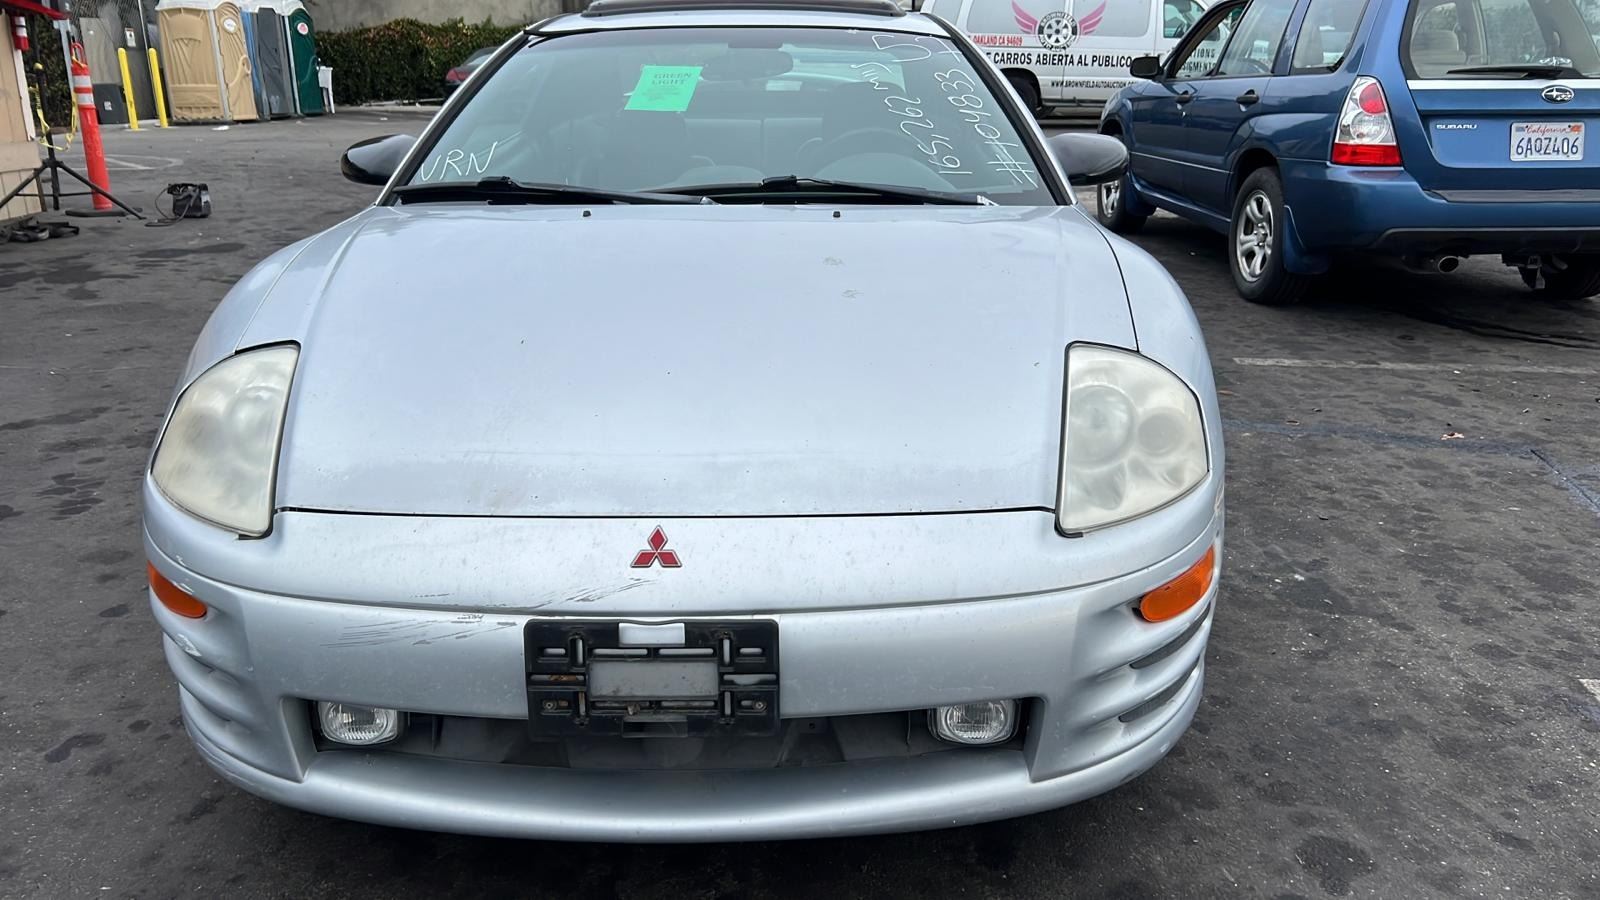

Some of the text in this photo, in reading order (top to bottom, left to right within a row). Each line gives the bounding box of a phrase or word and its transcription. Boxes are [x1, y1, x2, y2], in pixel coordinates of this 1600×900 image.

[999, 35, 1005, 45] CA
[993, 52, 1032, 65] CARROS
[1036, 53, 1074, 66] ABIERTA
[1077, 54, 1088, 66] AL
[1092, 55, 1132, 68] PUBLICO
[1526, 124, 1567, 136] California
[1516, 136, 1579, 156] 6AQZ406
